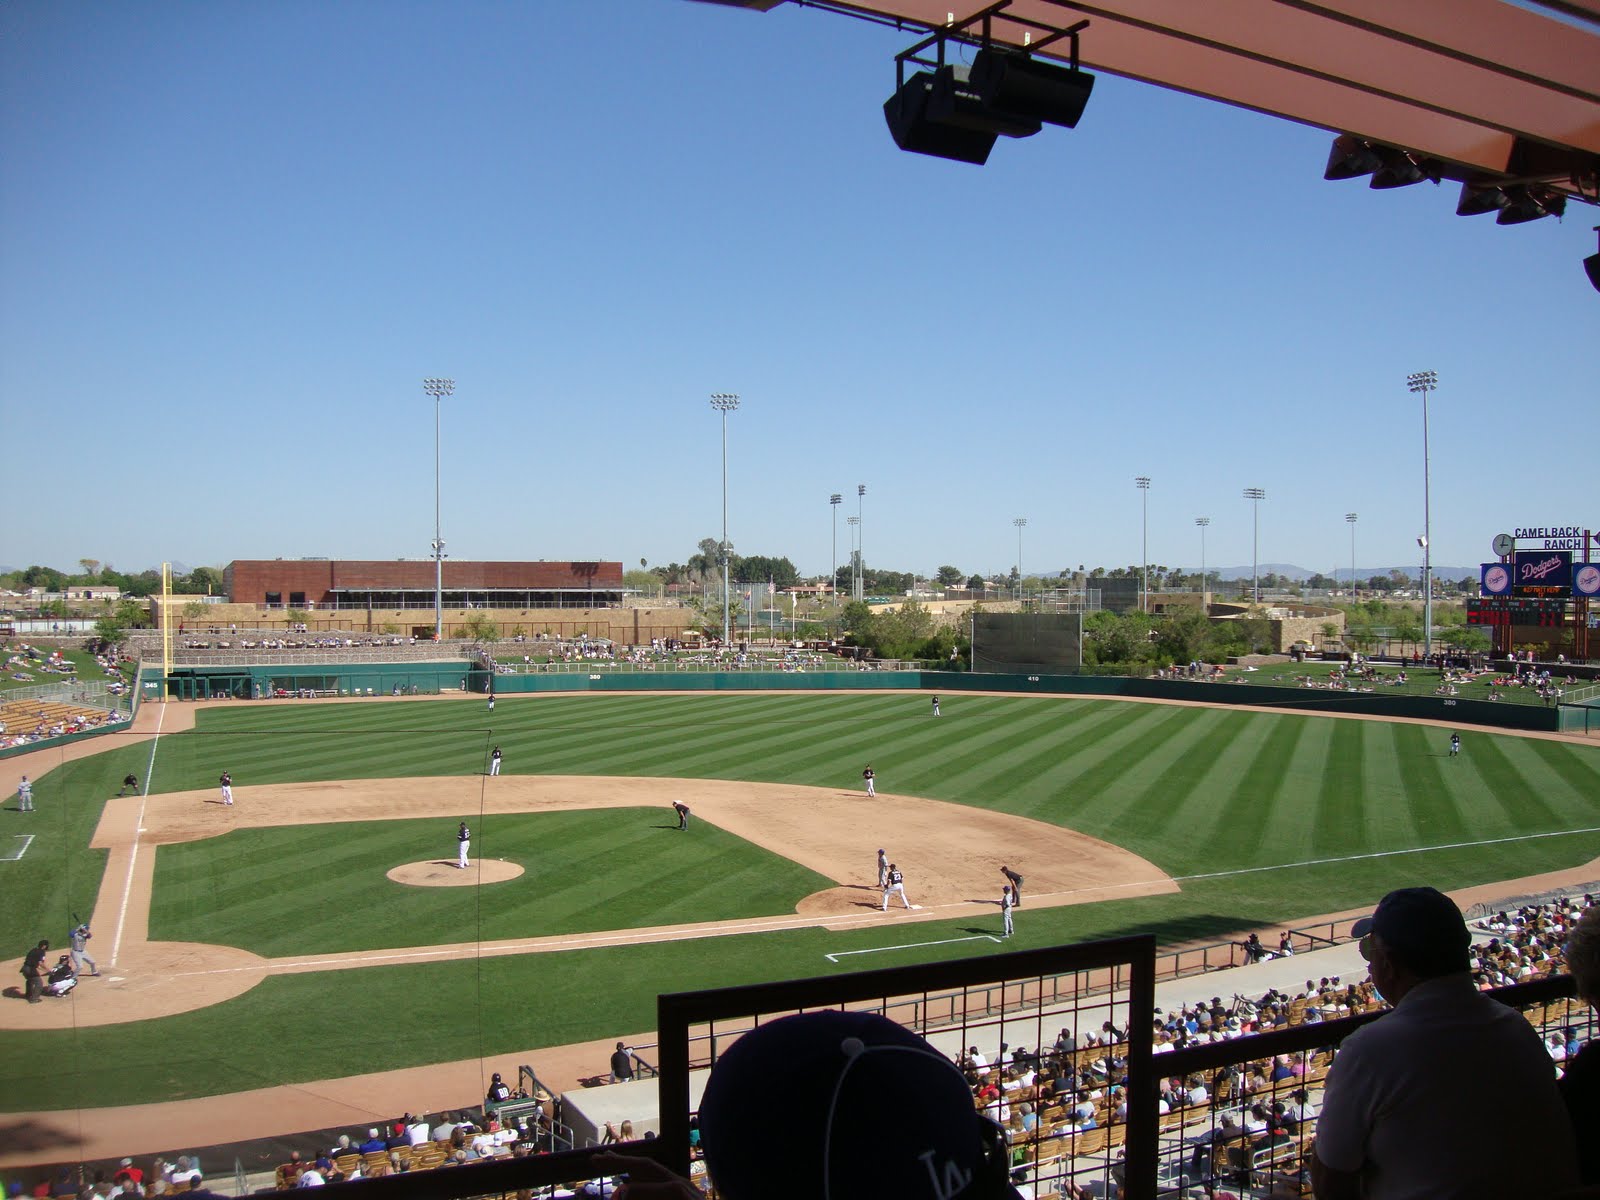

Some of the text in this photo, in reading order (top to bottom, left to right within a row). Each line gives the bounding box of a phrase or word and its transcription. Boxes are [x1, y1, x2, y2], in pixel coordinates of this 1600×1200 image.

[1515, 527, 1580, 538] CAMELBACK
[1544, 539, 1580, 549] RANCH
[1522, 555, 1561, 579] Dodgers
